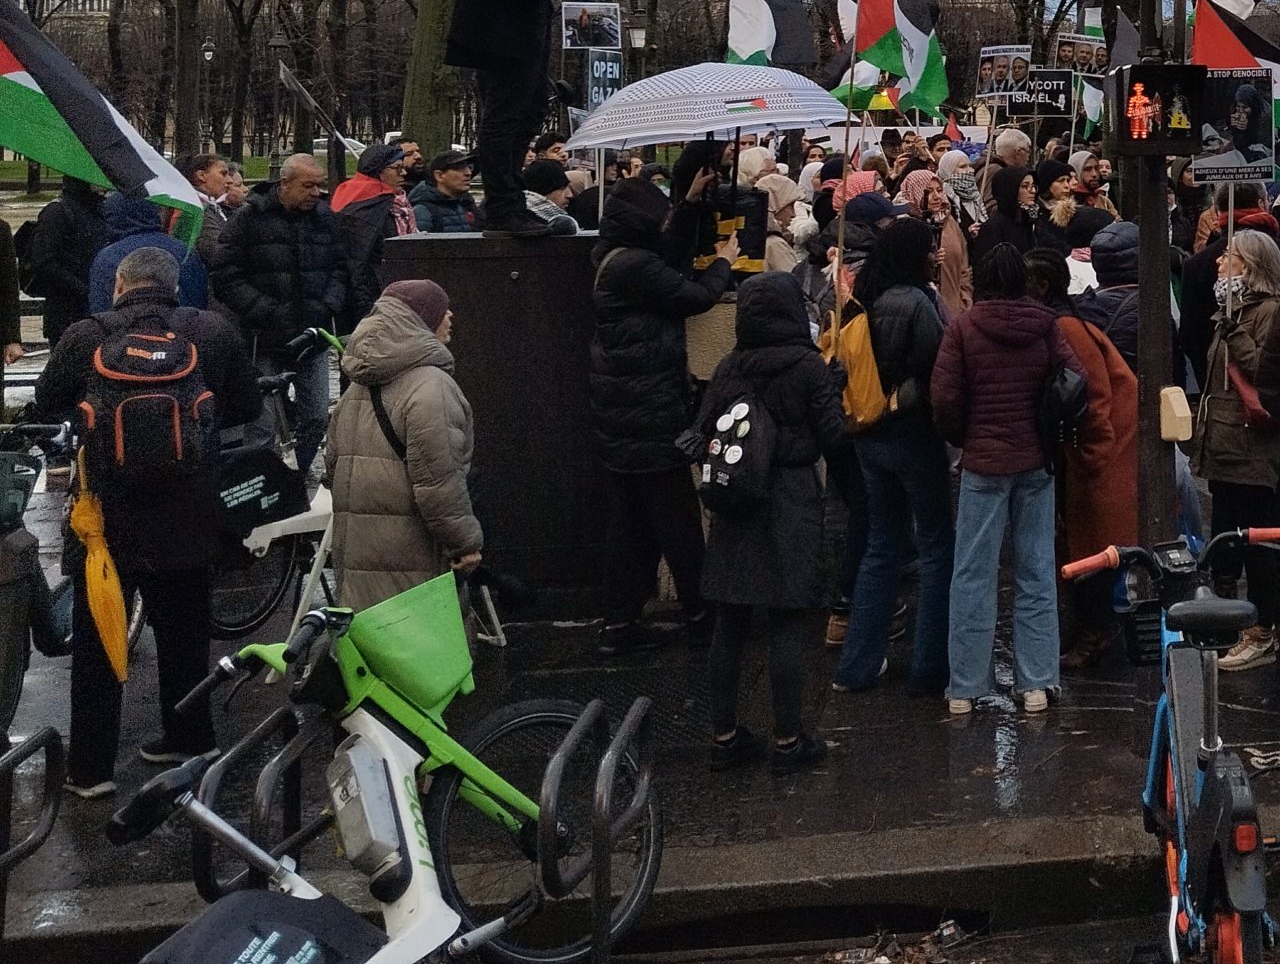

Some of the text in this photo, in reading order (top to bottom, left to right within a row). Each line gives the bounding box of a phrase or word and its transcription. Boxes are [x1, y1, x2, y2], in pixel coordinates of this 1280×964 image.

[593, 61, 620, 79] OPEN
[1028, 81, 1065, 90] YCOTT
[237, 937, 262, 962] TOUTE
